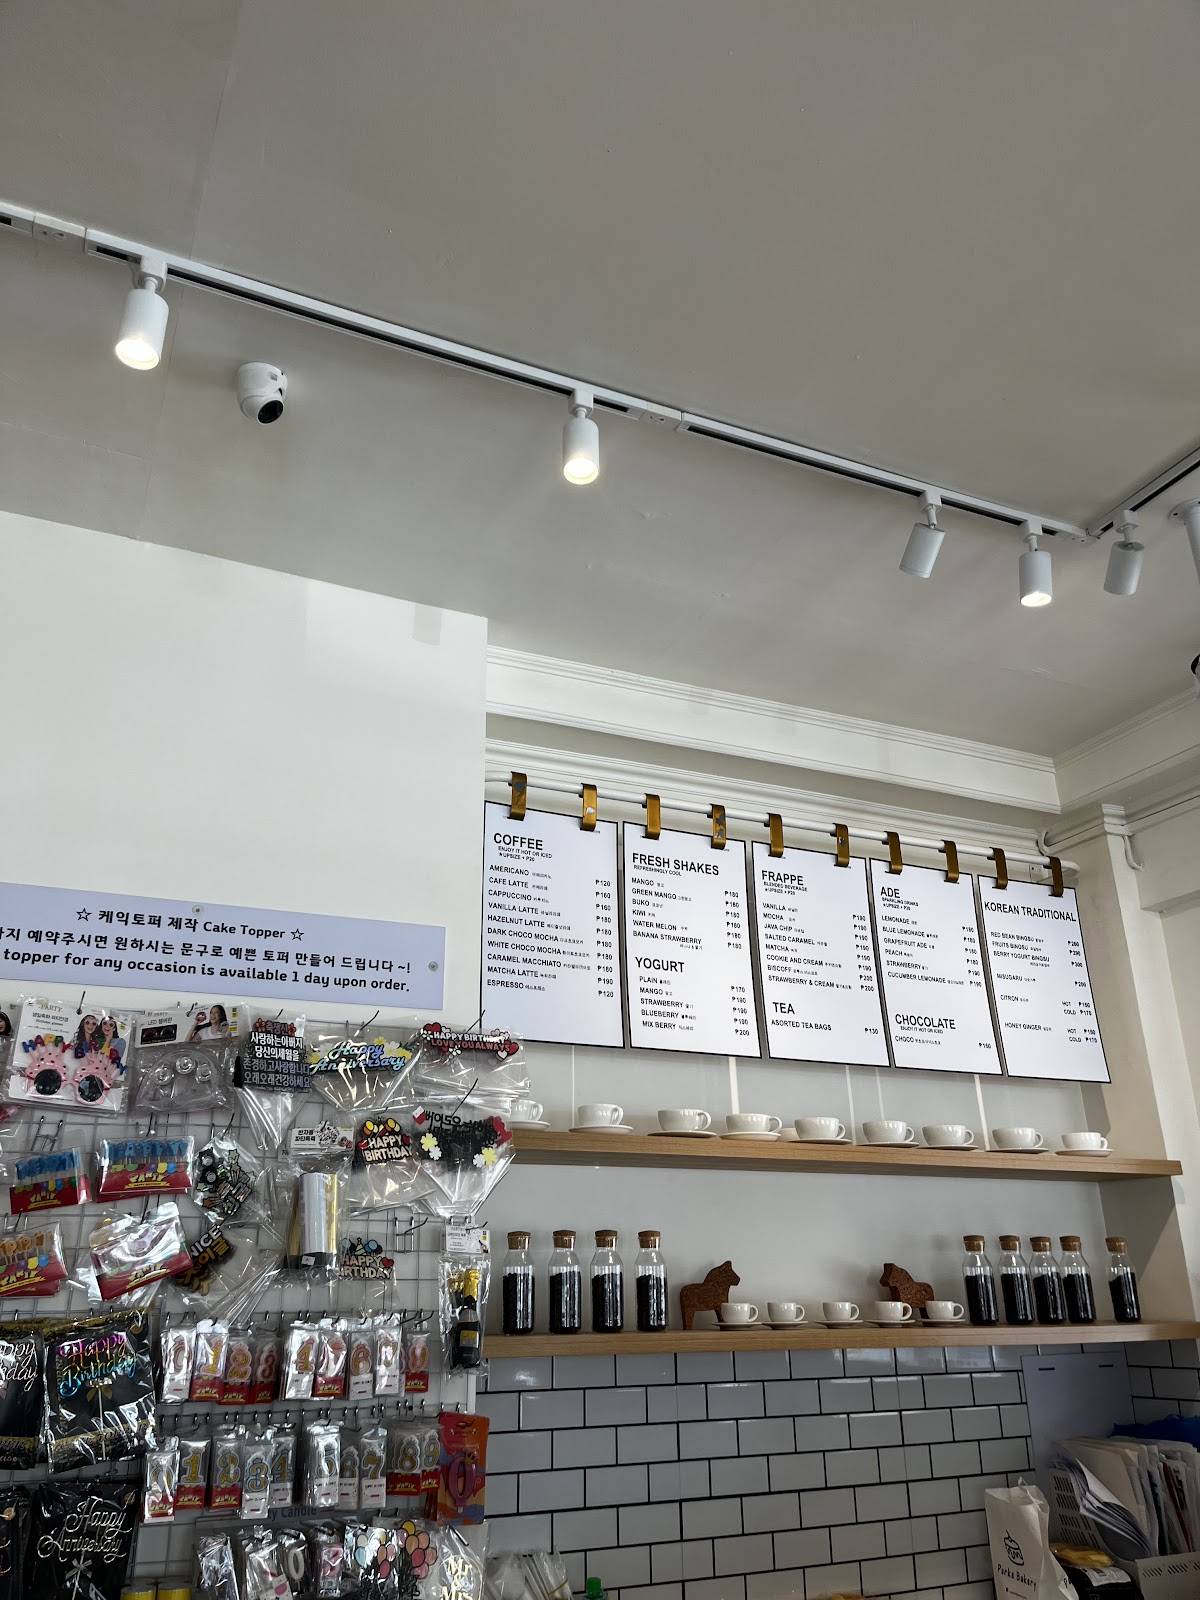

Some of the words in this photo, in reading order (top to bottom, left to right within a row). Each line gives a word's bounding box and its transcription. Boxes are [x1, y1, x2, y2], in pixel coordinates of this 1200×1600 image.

[494, 833, 543, 850] COFFEE
[490, 865, 529, 875] AMERICANO
[632, 853, 670, 868] FRESH
[674, 860, 719, 875] SHAKES
[634, 865, 667, 874] REFRESHINGLY
[489, 877, 506, 885] CAFE
[508, 880, 528, 888] LATTE
[632, 878, 654, 886] MANGO
[761, 870, 804, 886] FRAPPE
[488, 890, 532, 901] CAPPUCCINO
[632, 888, 652, 896] GREEN
[654, 891, 676, 900] MANGO
[881, 886, 900, 898] ADE
[488, 902, 516, 911] VANILLA
[519, 906, 538, 914] LATTE
[763, 903, 786, 911] VANILLA
[984, 901, 1019, 915] KOREAN
[1021, 906, 1076, 922] TRADITIONAL
[98, 910, 162, 928] 케익토퍼
[168, 916, 198, 932] 제작
[203, 921, 236, 934] Cake
[240, 924, 285, 940] Topper
[488, 915, 523, 924] HAZELNUT
[525, 919, 544, 928] LATTE
[633, 920, 653, 928] WATER
[656, 922, 676, 930] MELON
[882, 916, 910, 924] LEMONADE
[488, 928, 506, 936] DARK
[508, 930, 532, 939] CHOCO
[534, 933, 558, 942] MOCHA
[633, 931, 659, 939] BANANA
[660, 934, 701, 944] STRAWBERRY
[897, 928, 925, 937] LEMONADE
[788, 936, 815, 945] CARAMEL
[884, 938, 915, 947] GRAPEFRUIT
[28, 929, 108, 948] 예약주시면
[115, 937, 174, 955] 원하시는
[181, 943, 224, 957] 문구로
[229, 947, 257, 962] 예쁜
[263, 950, 289, 964] 토퍼
[296, 953, 335, 967] 만들어
[488, 940, 508, 949] WHITE
[511, 943, 535, 952] CHOCO
[537, 946, 561, 955] MOCHA
[765, 944, 789, 952] MATCHA
[487, 954, 520, 963] CARAMEL
[522, 957, 561, 968] MACCHIATO
[635, 956, 684, 972] YOGURT
[886, 960, 921, 969] STRAWBERRY
[3, 949, 59, 964] topper
[64, 953, 90, 965] for
[94, 957, 122, 972] any
[127, 959, 196, 974] occasion
[201, 964, 214, 976] is
[220, 967, 287, 982] available
[292, 972, 299, 982] 1
[304, 972, 329, 987] day
[334, 977, 366, 988] upon
[371, 979, 410, 992] order.
[487, 966, 516, 975] MATCHA
[518, 969, 538, 978] LATTE
[767, 965, 791, 973] BISCOFF
[768, 975, 807, 985] STRAWBERRY
[814, 980, 834, 988] CREAM
[888, 972, 916, 980] CUCUMBER
[918, 975, 946, 983] LEMONADE
[487, 979, 523, 989] ESPRESSO
[639, 987, 663, 995] MANGO
[640, 998, 683, 1008] STRAWBERRY
[773, 1002, 795, 1014] TEA
[641, 1009, 679, 1018] BLUEBERRY
[655, 1021, 676, 1029] BERRY
[771, 1019, 800, 1028] ASORTED
[895, 1013, 956, 1030] CHOCOLATE
[434, 1032, 463, 1041] HAPPY
[328, 1039, 384, 1059] Happy
[475, 1042, 510, 1052] ALWAYS
[368, 1134, 402, 1148] HAPPY
[364, 1146, 412, 1161] BIRTHDAY
[343, 1254, 382, 1267] HAPPY
[57, 1332, 126, 1363] Happy
[60, 1354, 136, 1397] Birthday
[65, 1496, 132, 1539] Happy
[37, 1526, 127, 1563] Anniversary
[448, 1556, 472, 1576] Mr
[998, 1564, 1014, 1579] Parks
[1017, 1571, 1036, 1592] Bakery
